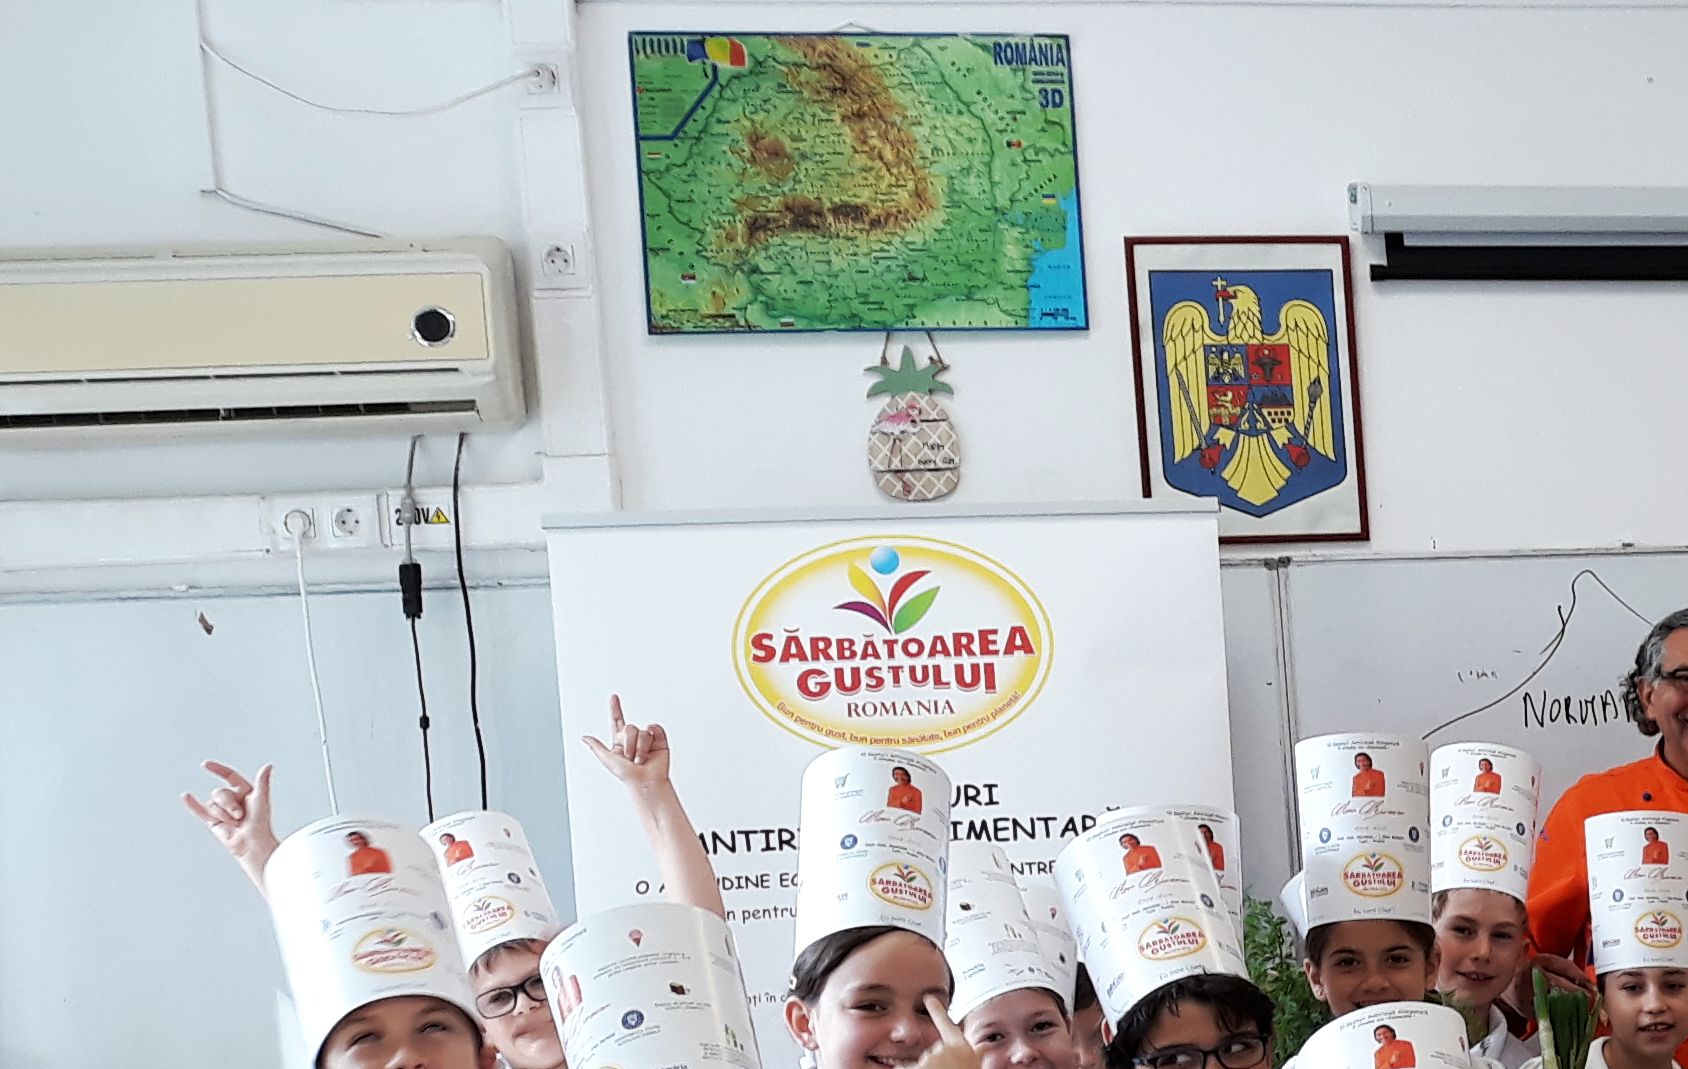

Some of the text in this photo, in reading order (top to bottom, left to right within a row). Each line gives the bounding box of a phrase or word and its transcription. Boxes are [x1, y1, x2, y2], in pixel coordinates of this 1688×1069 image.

[1038, 88, 1064, 109] 3D
[750, 626, 1036, 664] SĂRBĂTOAREA
[796, 662, 998, 702] GUSTULUI
[846, 698, 957, 718] ROMANIA
[741, 906, 798, 924] pentru
